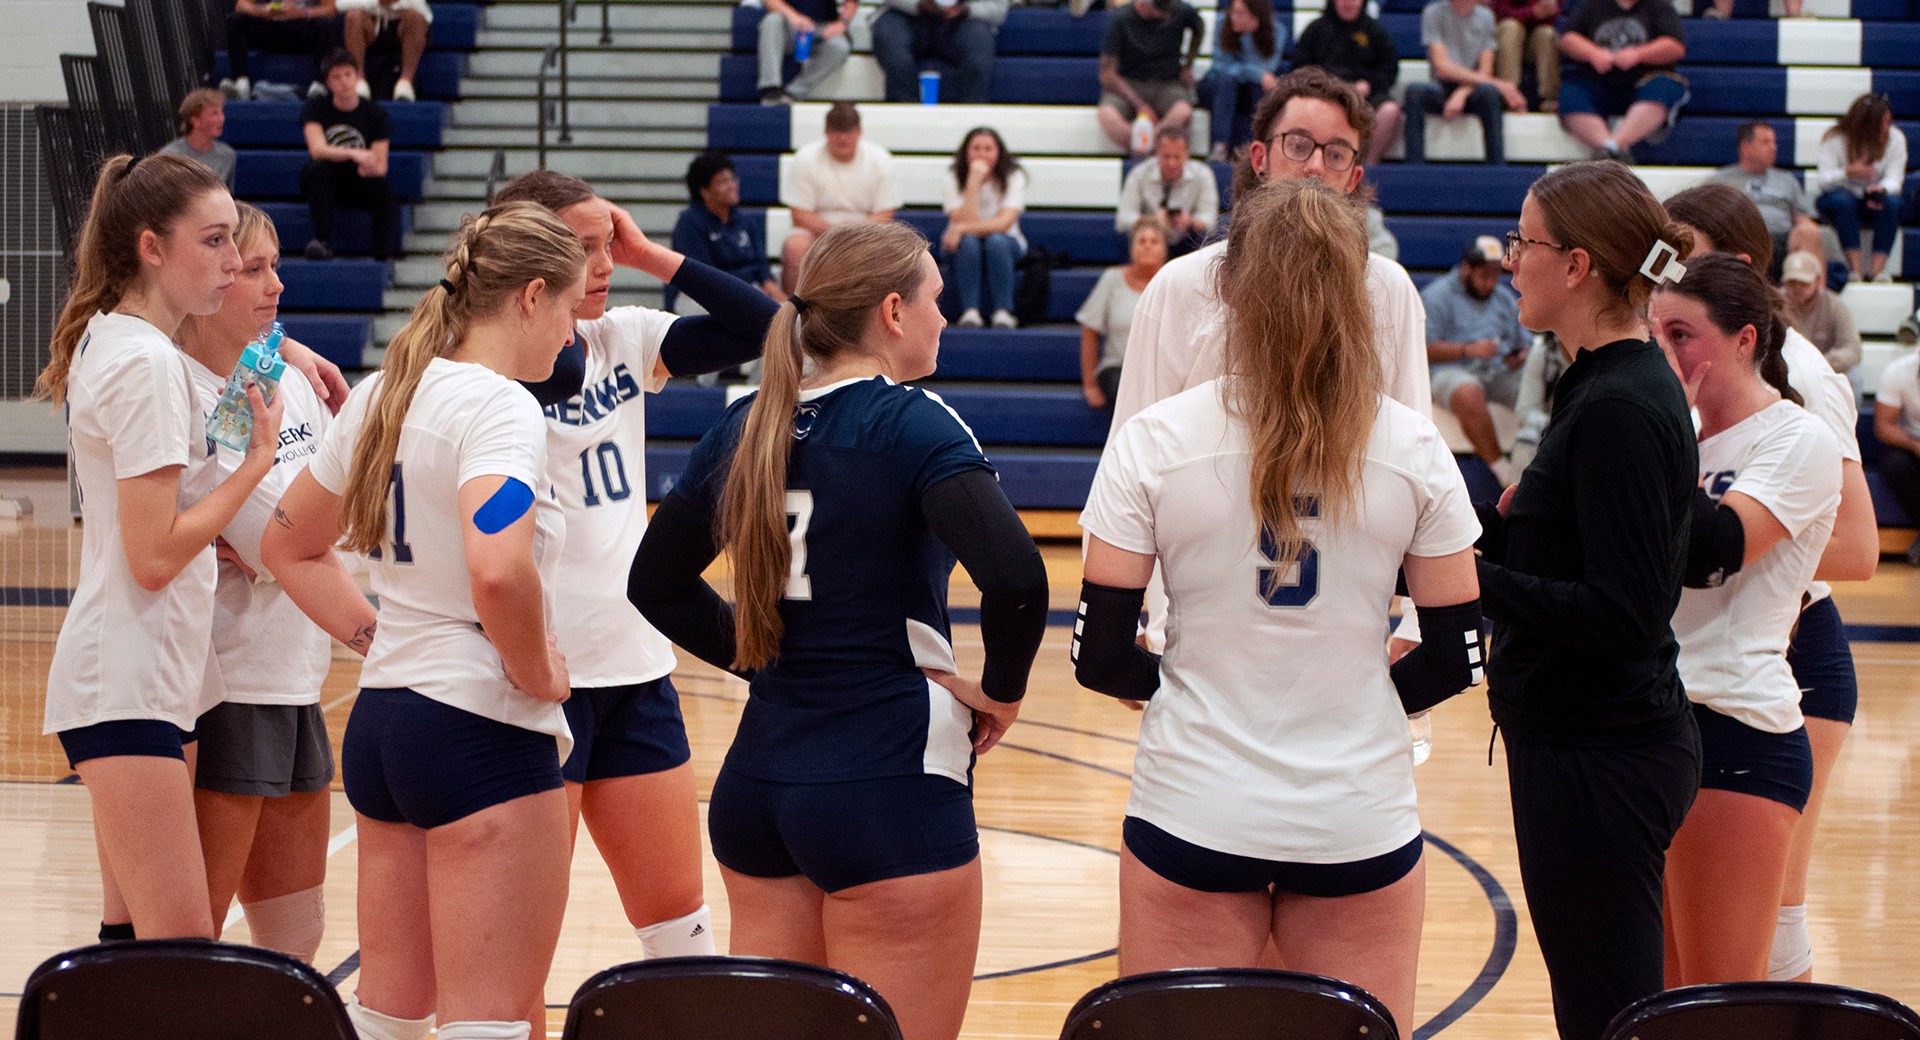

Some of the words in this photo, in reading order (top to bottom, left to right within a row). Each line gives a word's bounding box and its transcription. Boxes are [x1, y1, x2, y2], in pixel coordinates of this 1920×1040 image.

[277, 422, 313, 450] ERK
[579, 439, 632, 508] 10
[368, 461, 414, 566] 1
[784, 489, 815, 601] 7
[1256, 493, 1321, 611] 5
